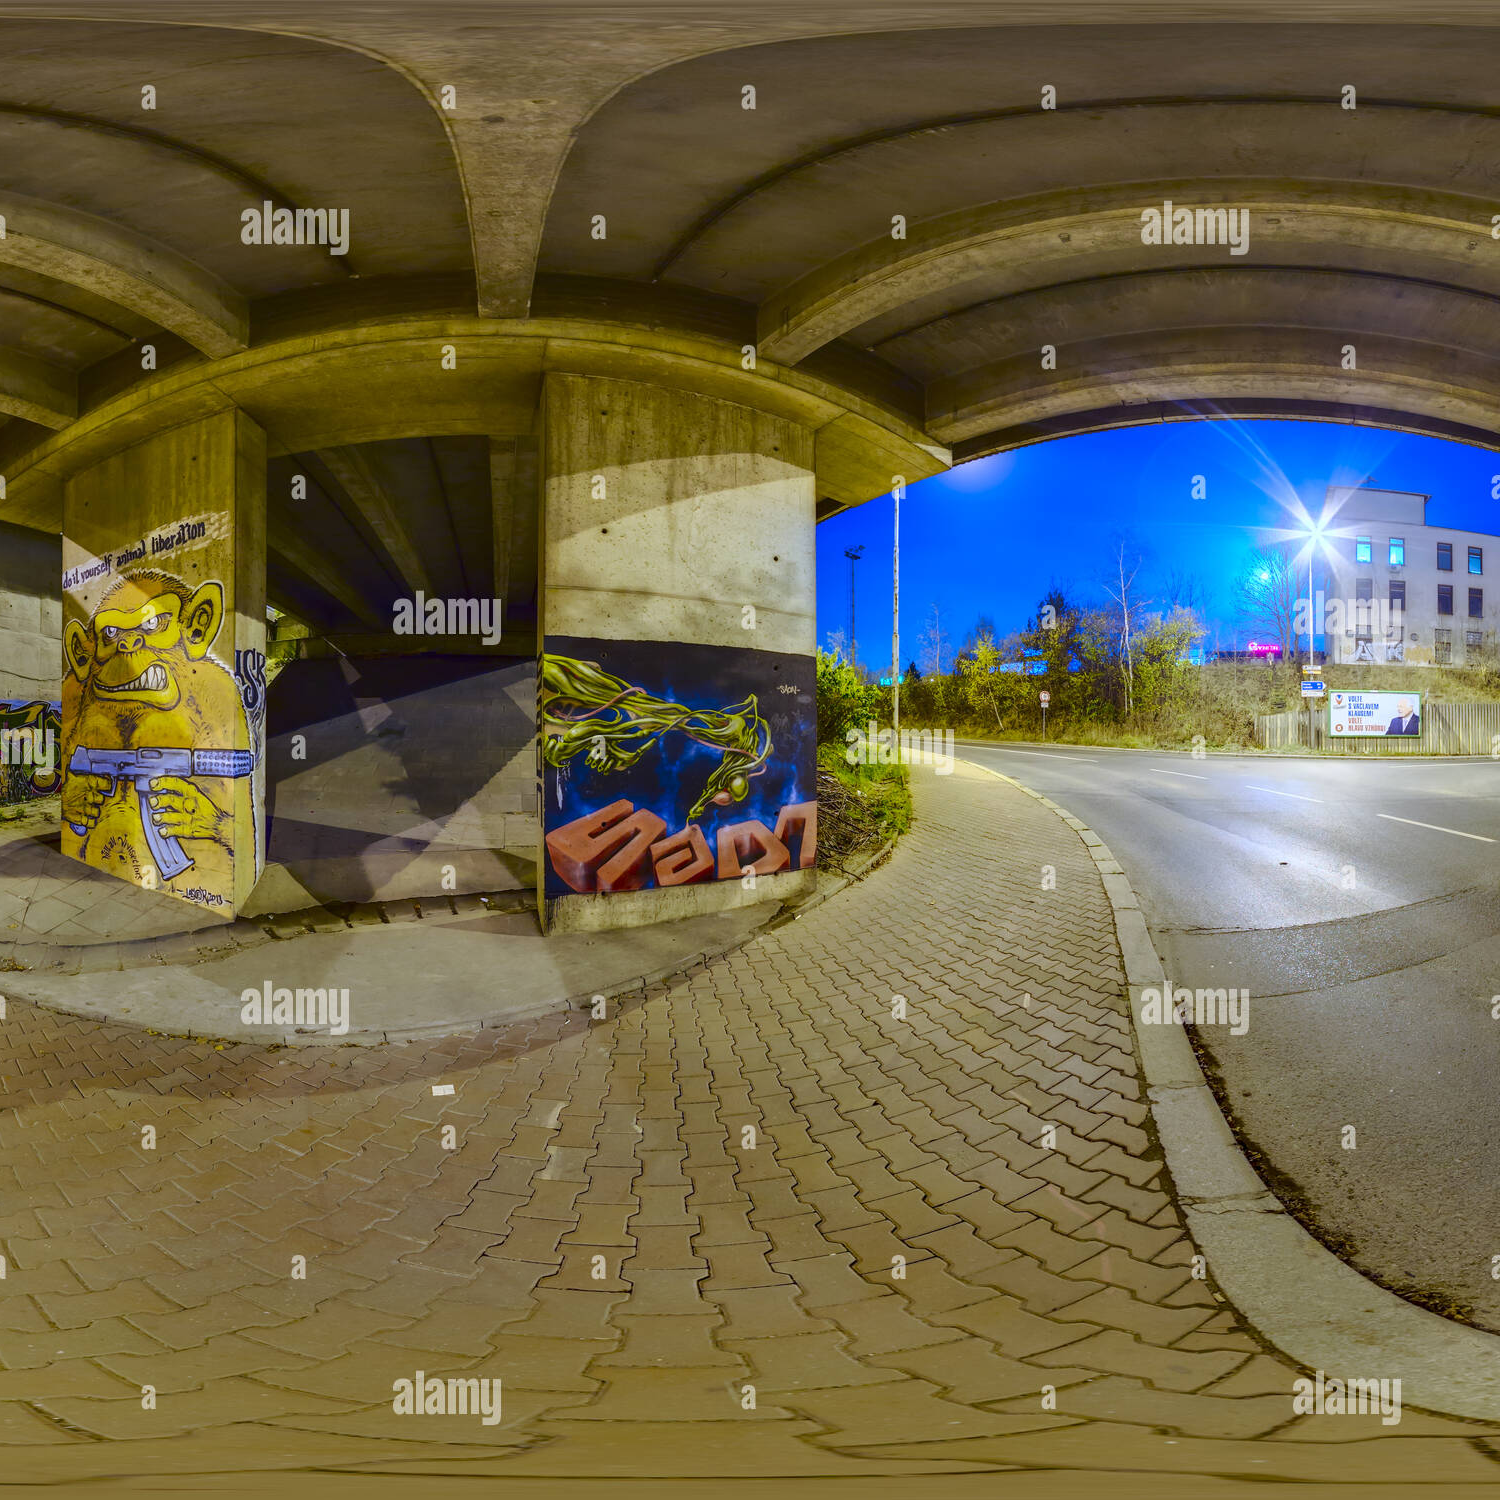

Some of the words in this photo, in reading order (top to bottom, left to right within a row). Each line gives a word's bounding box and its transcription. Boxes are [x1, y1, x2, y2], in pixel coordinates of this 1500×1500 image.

[81, 554, 112, 583] yourself
[116, 540, 147, 567] animal
[151, 521, 206, 555] liberation
